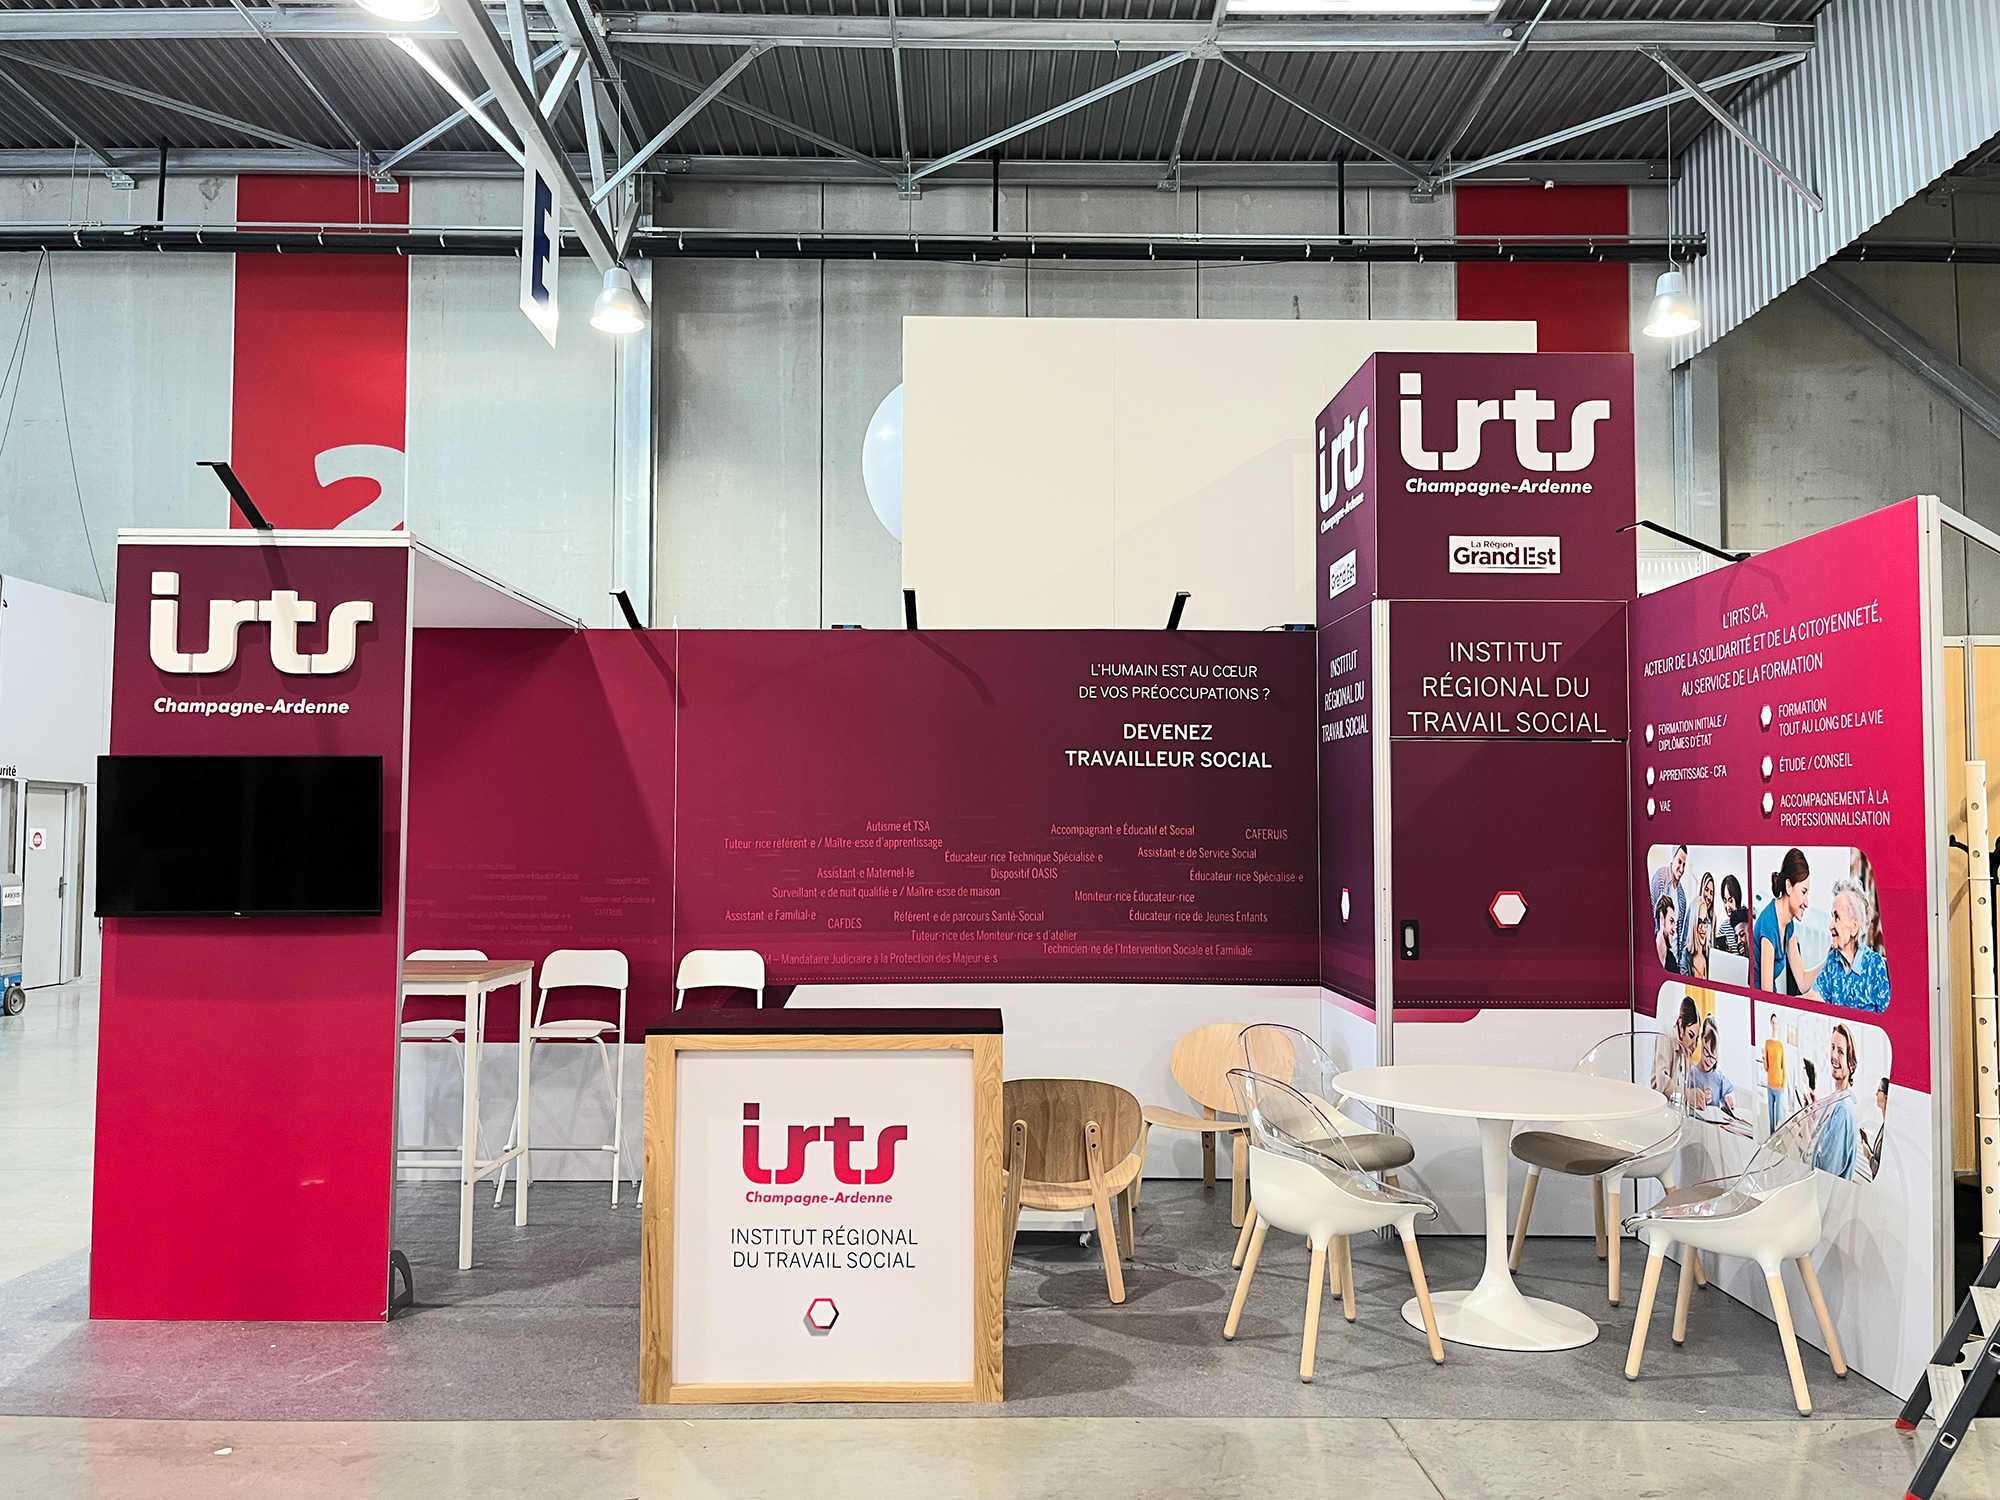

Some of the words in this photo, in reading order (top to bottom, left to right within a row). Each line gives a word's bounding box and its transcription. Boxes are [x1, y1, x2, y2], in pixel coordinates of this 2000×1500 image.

[1400, 372, 1610, 471] irts
[1319, 406, 1369, 513] irts
[1405, 478, 1593, 496] Champagne-Ardenne
[1471, 541, 1481, 549] La
[1484, 541, 1513, 549] Région
[149, 571, 374, 674] irts
[1723, 607, 1750, 629] L'IRTS
[1751, 602, 1768, 622] CA,
[1644, 658, 1674, 677] ACTEUR
[1675, 655, 1686, 670] DE
[1687, 653, 1698, 668] LA
[1699, 634, 1751, 665] SOLIDARITÉ
[1754, 634, 1766, 652] ET
[1768, 630, 1781, 649] DE
[1783, 626, 1796, 644] LA
[1798, 599, 1882, 640] CITOYENNETÉ,
[1450, 642, 1563, 663] INSTITUT
[1091, 664, 1158, 677] L'HUMAIN
[1162, 665, 1187, 677] EST
[1190, 665, 1208, 678] AU
[1213, 665, 1258, 678] CŒUR
[1330, 649, 1358, 678] INSTITUT
[1681, 680, 1693, 696] AU
[1695, 672, 1731, 695] SERVICE
[1733, 669, 1745, 686] DE
[1748, 667, 1760, 683] LA
[1761, 653, 1823, 681] FORMATION
[1079, 686, 1097, 699] DE
[1100, 686, 1128, 699] VOS
[1132, 684, 1259, 700] PRÉOCCUPATIONS
[1264, 688, 1270, 700] ?
[1423, 672, 1549, 697] RÉGIONAL
[1556, 677, 1589, 697] DU
[1324, 686, 1354, 712] RÉGIONAL
[1355, 680, 1365, 702] DU
[154, 697, 350, 717] Champagne-Ardenne
[1779, 698, 1826, 717] FORMATION
[1322, 721, 1345, 743] TRAVAIL
[1345, 714, 1369, 738] SOCIAL
[1407, 712, 1510, 733] TRAVAIL
[1516, 712, 1607, 733] SOCIAL
[1658, 720, 1694, 736] FORMATION
[1695, 717, 1721, 731] INITIALE
[1779, 720, 1800, 736] TOUT
[1801, 718, 1813, 733] AU
[1814, 714, 1839, 732] LONG
[1841, 713, 1853, 727] DE
[1855, 711, 1868, 726] LA
[1868, 709, 1884, 724] VIE
[1123, 724, 1213, 741] DEVENEZ
[1659, 735, 1689, 752] DIPLÔMES
[1690, 733, 1712, 748] D'ÉTAT
[1065, 751, 1194, 767] TRAVAILLEUR
[1200, 752, 1272, 768] SOCIAL
[1779, 756, 1806, 773] ÉTUDE
[1808, 757, 1812, 770] /
[1814, 753, 1852, 769] CONSEIL
[1659, 766, 1708, 782] APPRENTISSAGE
[1714, 765, 1727, 777] CFA
[1780, 791, 1865, 808] ACCOMPAGNEMENT
[1868, 787, 1874, 804] À
[1876, 790, 1889, 804] LA
[866, 821, 901, 832] Autisme
[902, 822, 911, 832] et
[913, 821, 930, 832] TSA
[1781, 811, 1890, 826] PROFESSIONNALISATION
[1124, 822, 1157, 836] Éducatif
[1159, 826, 1168, 836] et
[1170, 826, 1194, 836] Social
[1246, 829, 1288, 840] CAFERUIS
[817, 839, 822, 848] /
[876, 838, 943, 850] d'apprentissage
[1008, 852, 1051, 864] Technique
[1187, 848, 1197, 858] de
[1199, 848, 1230, 859] Service
[1232, 848, 1257, 859] Social
[990, 868, 1030, 880] Dispositif
[1032, 869, 1058, 879] OASIS
[828, 888, 838, 898] de
[840, 888, 856, 898] nuit
[900, 887, 904, 897] /
[958, 886, 968, 896] de
[970, 887, 1000, 896] maison
[828, 918, 862, 929] CAFDES
[940, 912, 950, 922] de
[952, 913, 990, 924] parcours
[1192, 912, 1203, 922] de
[1205, 912, 1234, 922] Jeunes
[1236, 912, 1268, 922] Enfants
[960, 931, 974, 940] des
[1043, 930, 1077, 940] d'atelier
[782, 954, 829, 964] Mandataire
[831, 954, 871, 964] Judiciaire
[873, 954, 878, 964] à
[880, 954, 888, 963] la
[890, 953, 934, 964] Protection
[936, 953, 951, 963] des
[1103, 944, 1113, 954] de
[1115, 944, 1171, 954] l'Intervention
[1173, 944, 1203, 955] Sociale
[1205, 946, 1213, 955] et
[1216, 946, 1252, 956] Familiale
[742, 1102, 908, 1184] irts
[746, 1191, 893, 1206] Champagne-Ardenne
[731, 1228, 816, 1245] INSTITUT
[823, 1225, 918, 1245] RÉGIONAL
[733, 1252, 759, 1268] DU
[765, 1252, 841, 1268] TRAVAIL
[847, 1252, 915, 1268] SOCIAL
